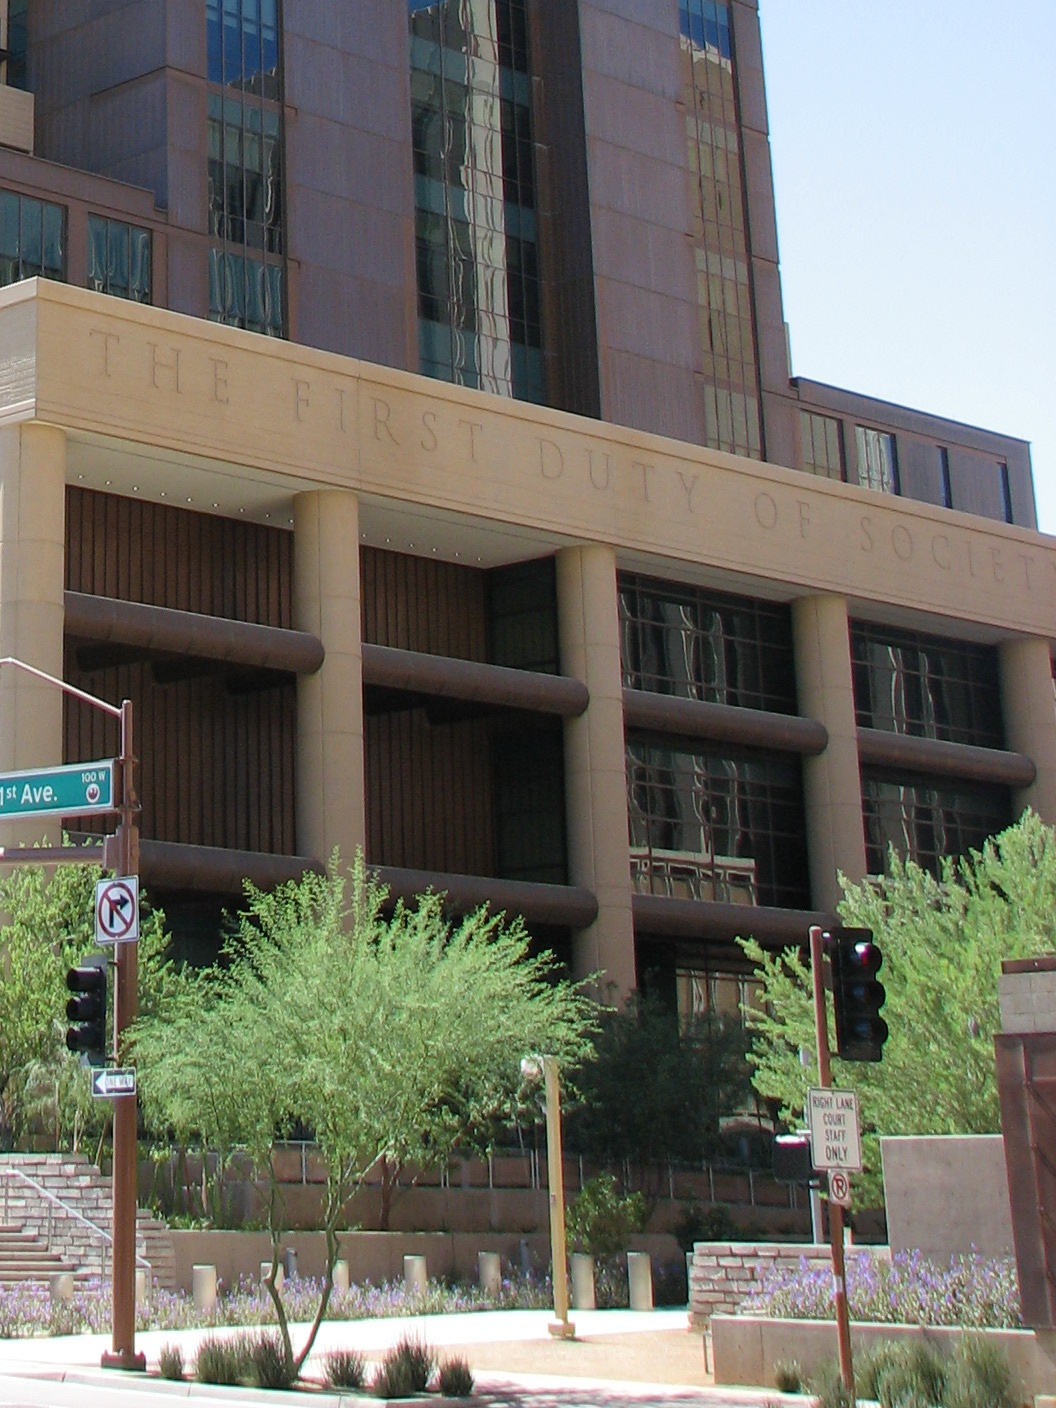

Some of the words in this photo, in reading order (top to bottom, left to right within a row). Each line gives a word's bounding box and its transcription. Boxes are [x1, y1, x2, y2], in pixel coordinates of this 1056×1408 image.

[89, 329, 229, 405] THE
[291, 378, 482, 462] FIRST
[535, 437, 699, 513] DUTY
[754, 493, 810, 538] OF
[860, 516, 1056, 589] SOCIET
[82, 772, 96, 783] 100
[98, 771, 106, 781] W
[21, 783, 58, 804] Ave.
[813, 1096, 832, 1109] RIGHT
[835, 1097, 854, 1110] LANE
[823, 1112, 846, 1126] COURT
[825, 1129, 846, 1142] STAFF
[825, 1145, 848, 1161] ONLY
